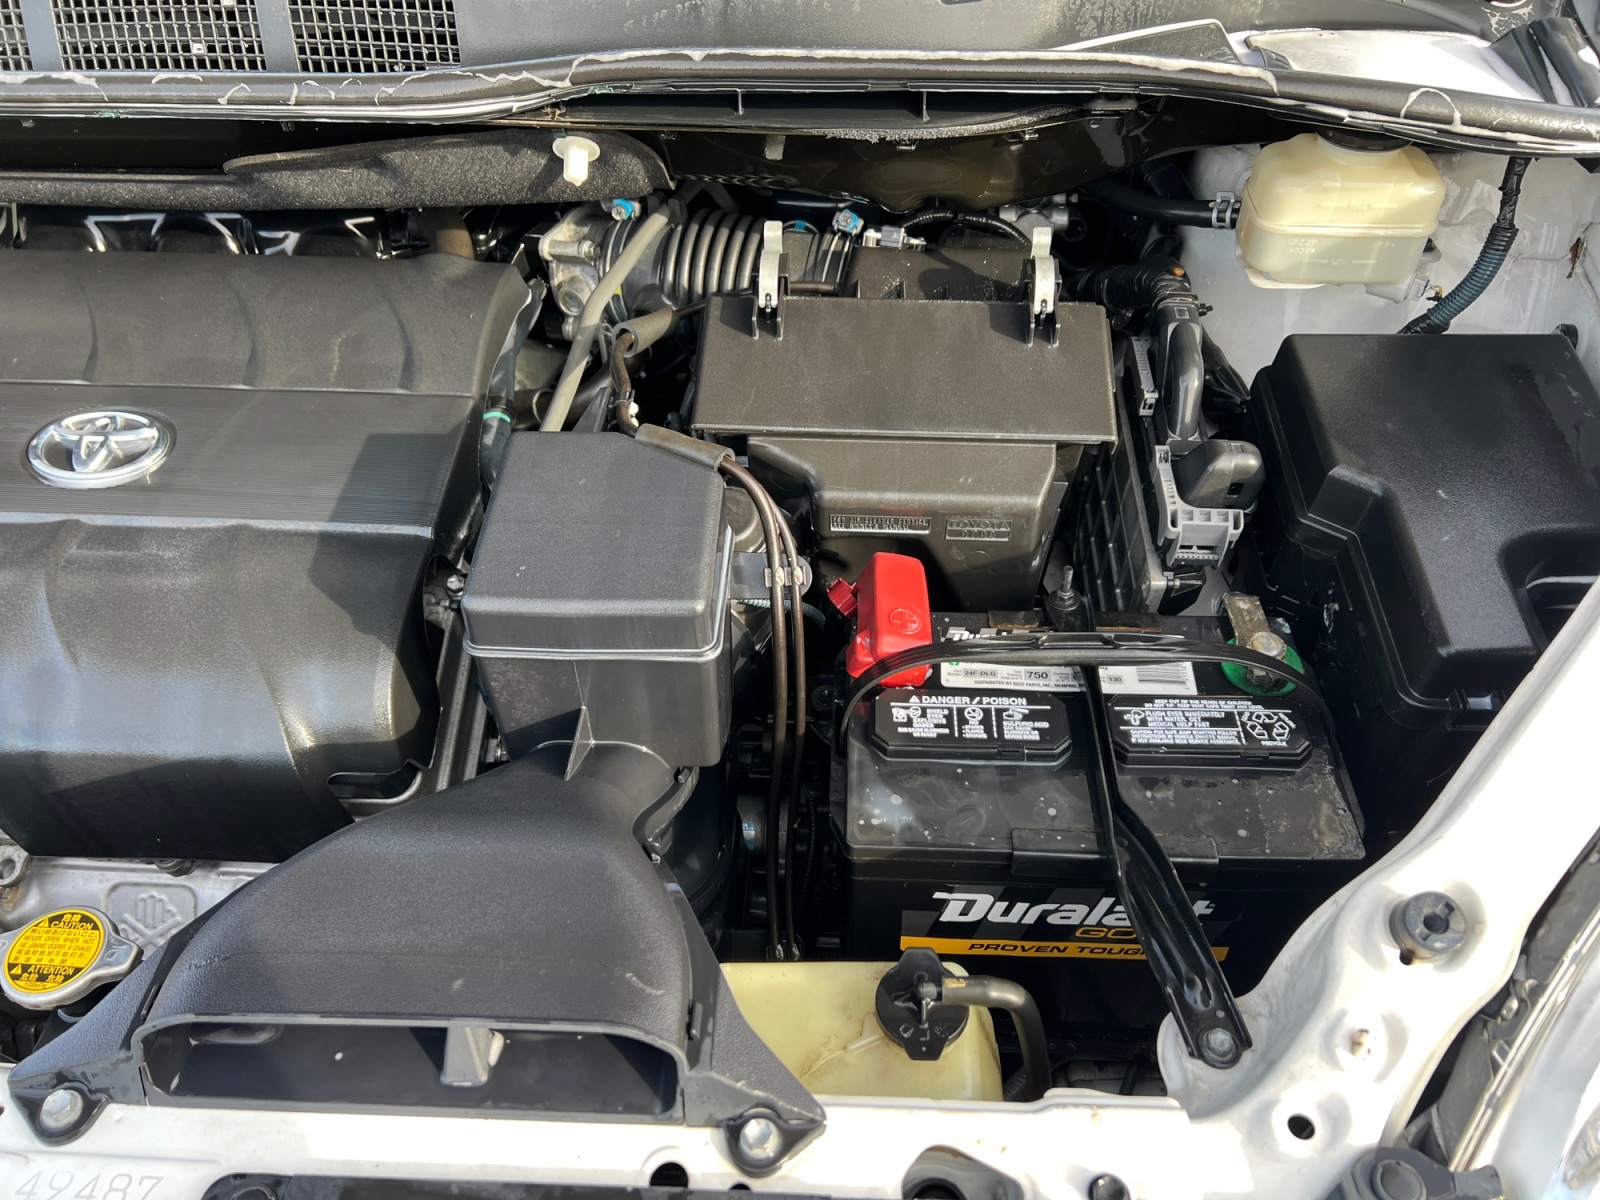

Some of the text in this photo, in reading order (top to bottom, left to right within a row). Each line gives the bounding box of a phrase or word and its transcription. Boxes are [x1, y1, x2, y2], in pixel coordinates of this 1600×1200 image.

[949, 519, 1010, 530] TOYOTA
[1027, 671, 1048, 679] 750
[921, 696, 970, 704] DANGER
[982, 697, 1027, 705] POISON
[932, 892, 1214, 926] Duralat
[51, 921, 93, 931] CAUTION
[1074, 926, 1138, 940] GO
[968, 943, 1144, 956] PROVEN TOUG
[28, 964, 75, 976] ATTENTION
[14, 1170, 164, 1200] 49487
